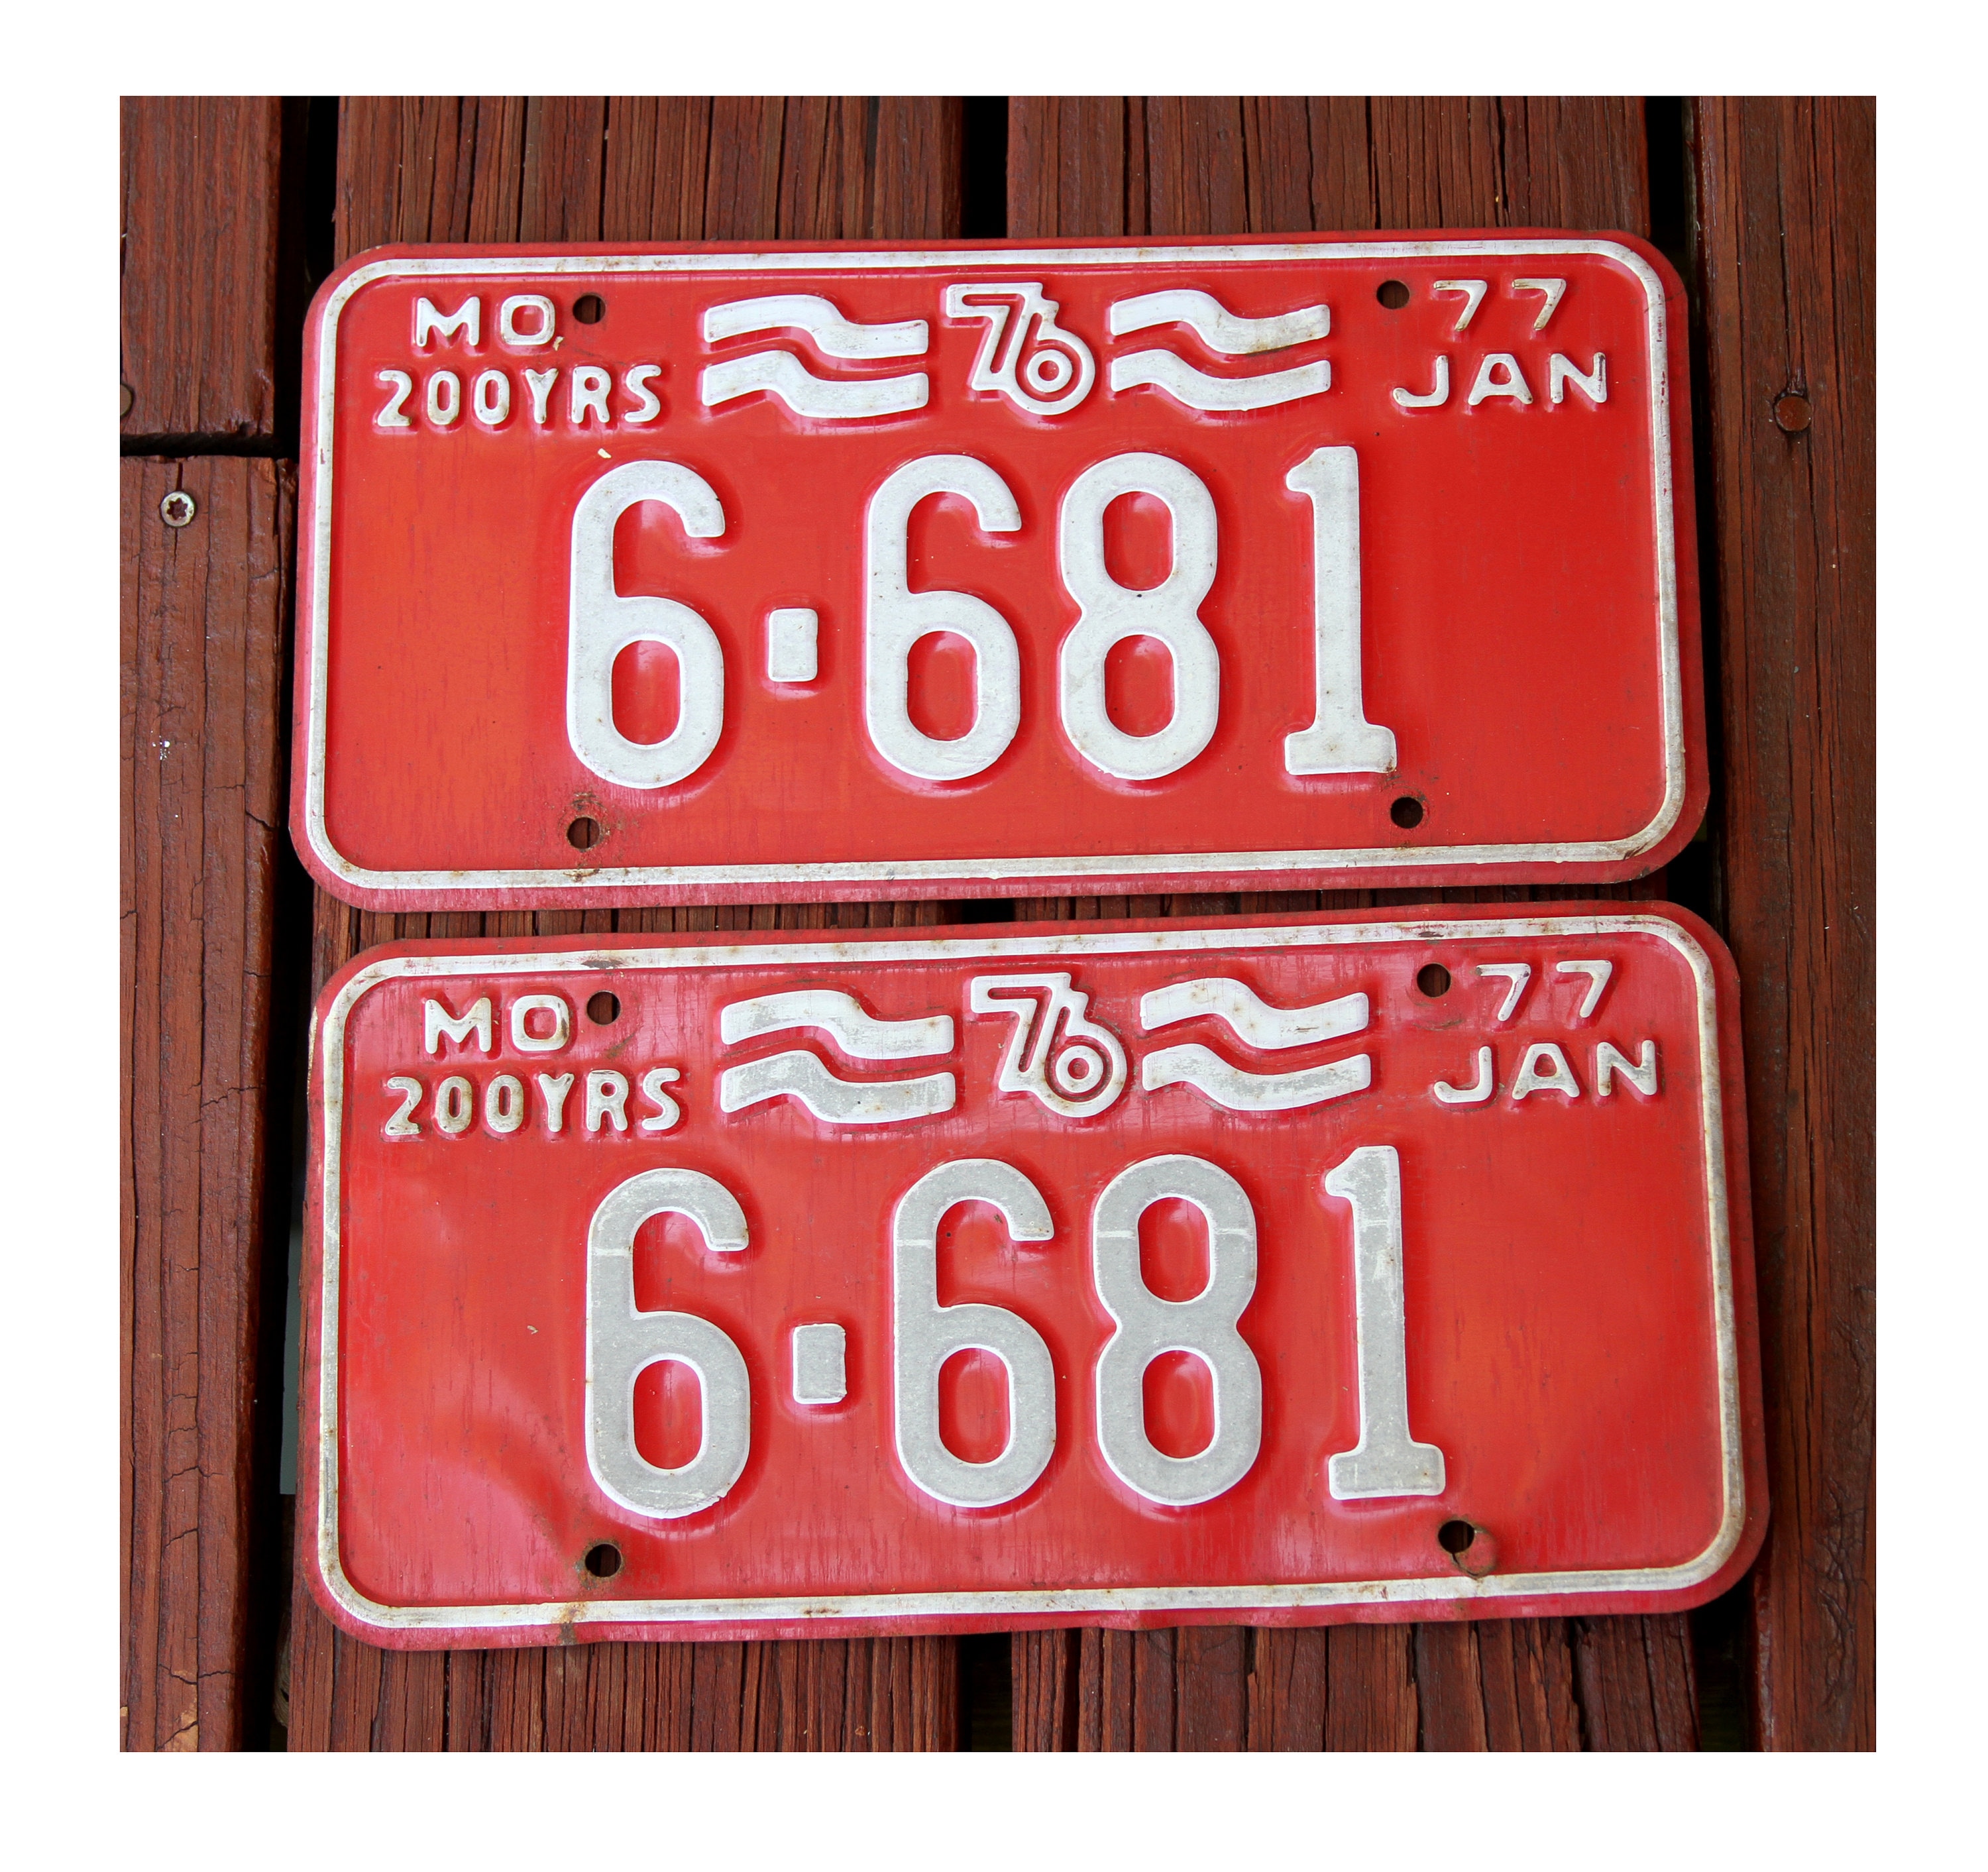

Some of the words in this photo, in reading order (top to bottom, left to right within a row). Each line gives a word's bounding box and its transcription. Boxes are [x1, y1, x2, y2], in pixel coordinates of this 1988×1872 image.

[415, 295, 555, 347] MO
[1433, 278, 1567, 331] 77
[946, 282, 1096, 415] 76
[1392, 352, 1608, 408] JAN
[1475, 960, 1613, 1021] 77
[424, 994, 571, 1055] MO
[970, 972, 1128, 1118] 76
[1433, 1039, 1657, 1104] JAN
